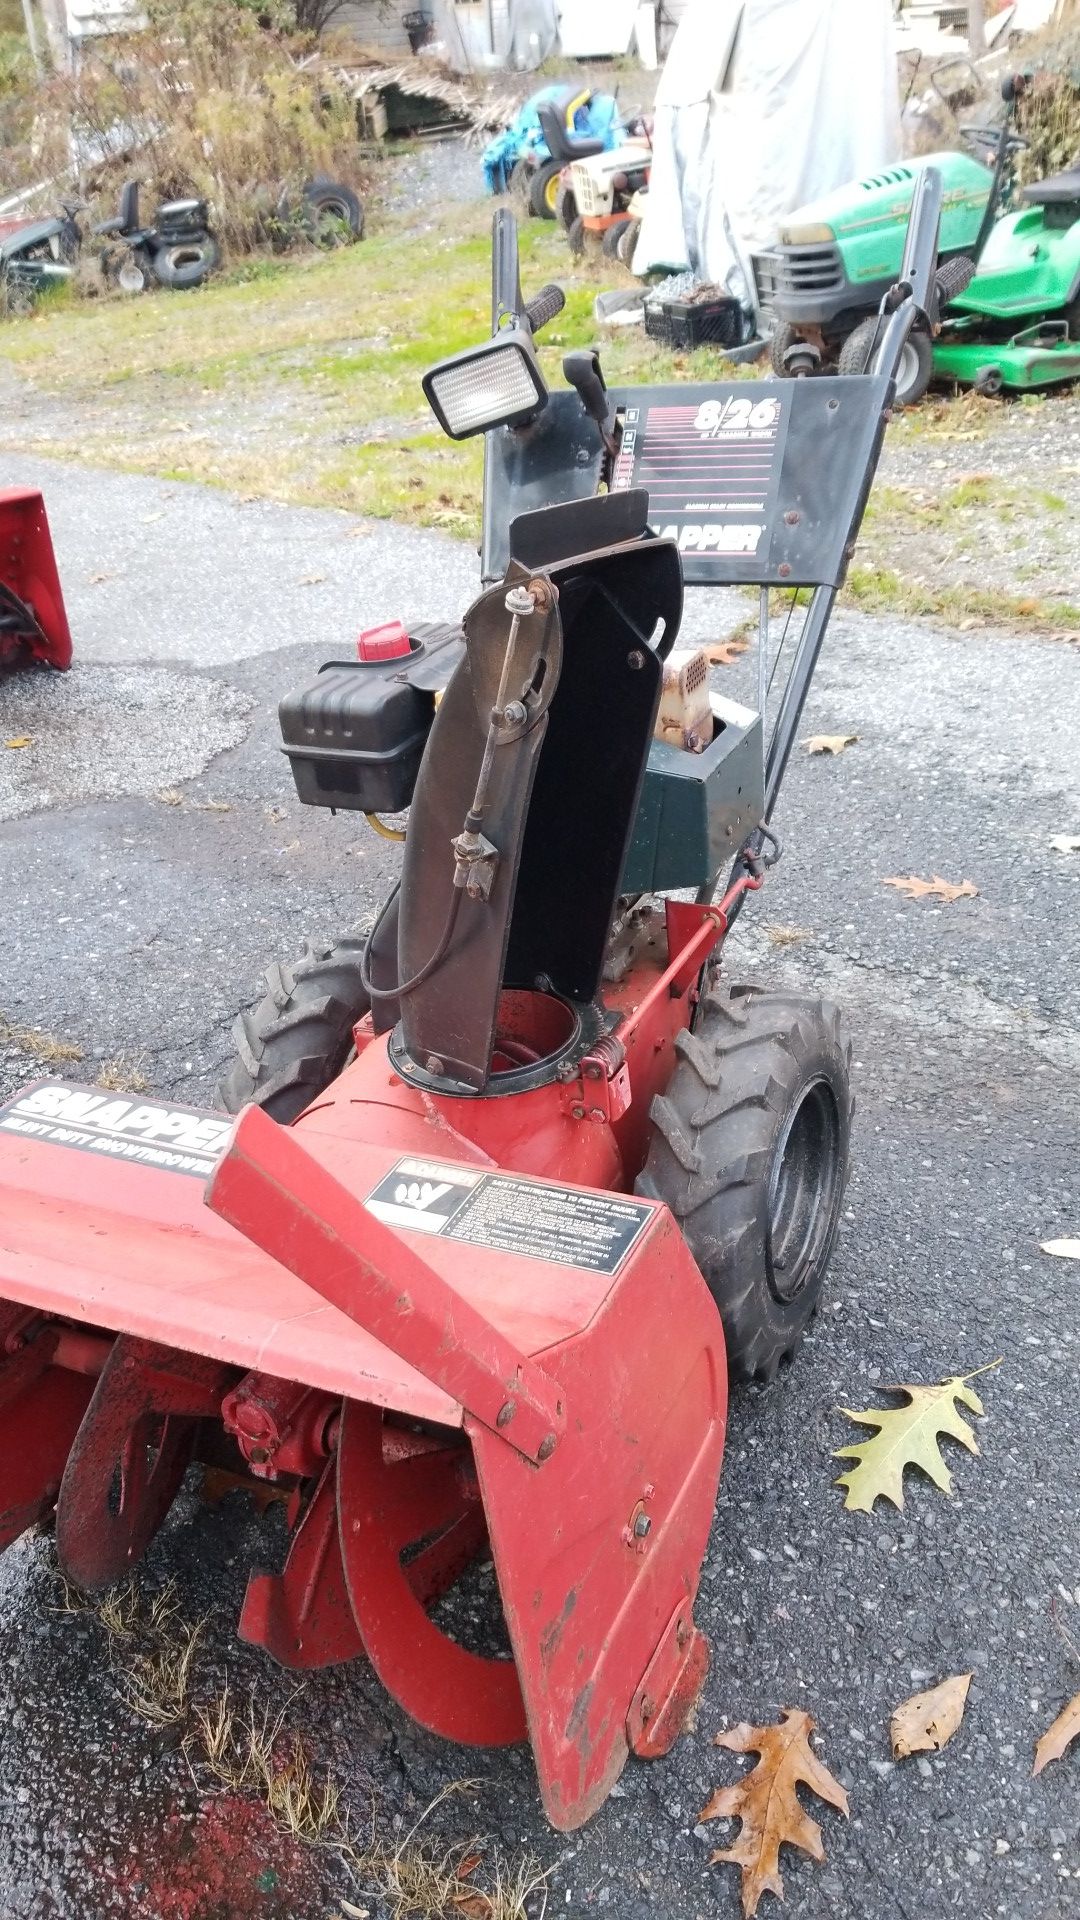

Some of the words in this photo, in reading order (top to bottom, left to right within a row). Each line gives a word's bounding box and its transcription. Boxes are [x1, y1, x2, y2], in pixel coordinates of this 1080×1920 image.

[693, 395, 777, 437] 8/26
[0, 1117, 54, 1136] HEAVY
[48, 1127, 97, 1144] DUTY
[491, 1180, 518, 1189] SAFETY
[518, 1186, 567, 1200] INSTRUCTIONS
[578, 1199, 611, 1209] PREVENT
